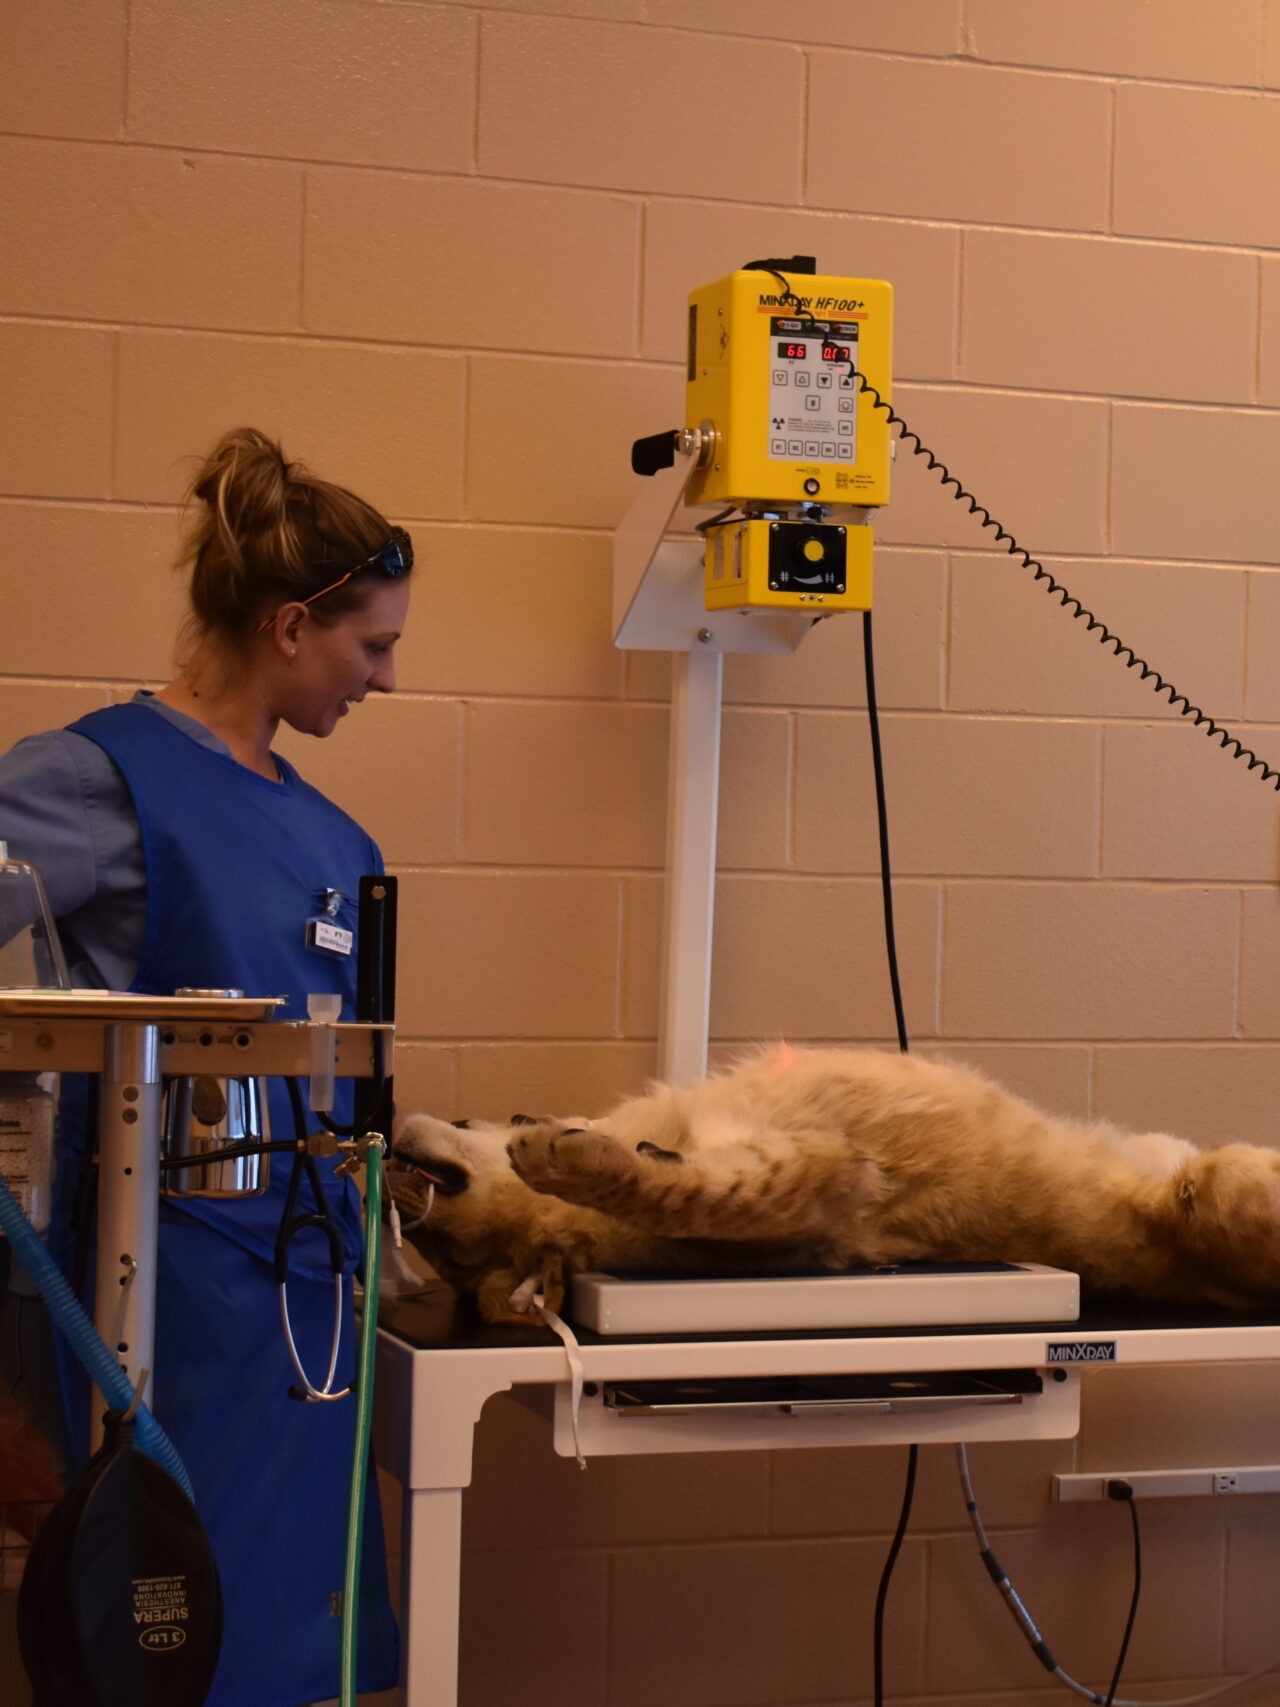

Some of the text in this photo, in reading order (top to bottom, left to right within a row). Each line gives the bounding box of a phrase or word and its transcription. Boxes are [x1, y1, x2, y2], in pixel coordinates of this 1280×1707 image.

[815, 297, 865, 312] HF100+
[787, 345, 805, 358] 66
[1049, 1343, 1113, 1361] MINXRAY
[133, 1590, 187, 1601] INNOVATIONS
[135, 1597, 186, 1608] ANESTHESIA
[133, 1607, 189, 1624] SUPERA
[148, 1631, 181, 1644] 3 Ltr
